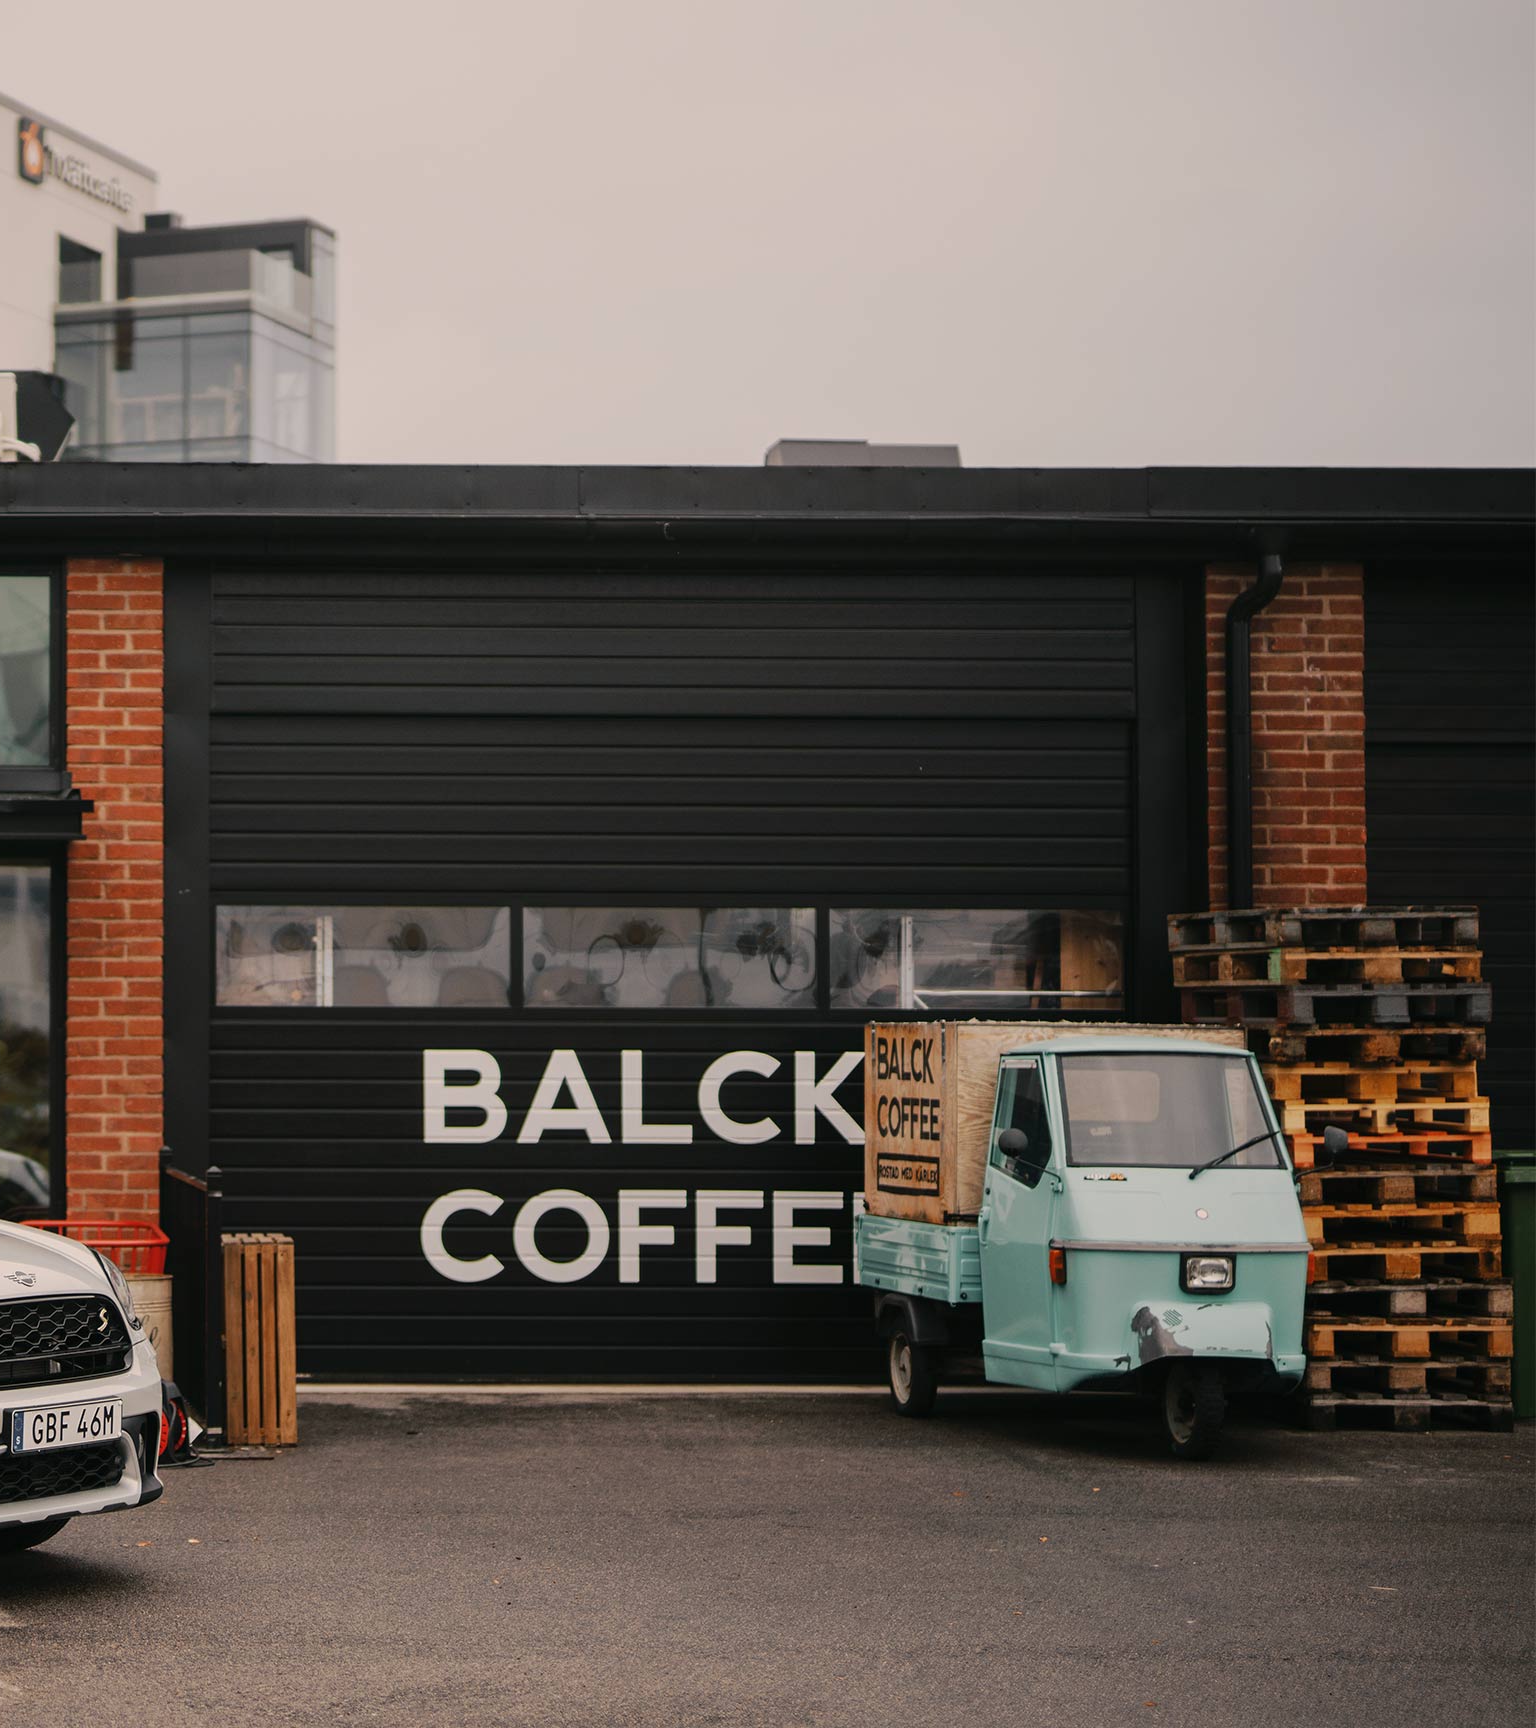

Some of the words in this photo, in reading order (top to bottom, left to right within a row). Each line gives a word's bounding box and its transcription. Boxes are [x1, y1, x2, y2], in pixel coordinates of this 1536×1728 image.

[877, 1037, 934, 1084] BALCK
[423, 1049, 865, 1145] BALCK
[877, 1095, 940, 1141] COFFEE
[420, 1188, 865, 1284] COFFE
[15, 1435, 21, 1446] S
[32, 1411, 70, 1444] GBF
[77, 1405, 114, 1438] 46M
